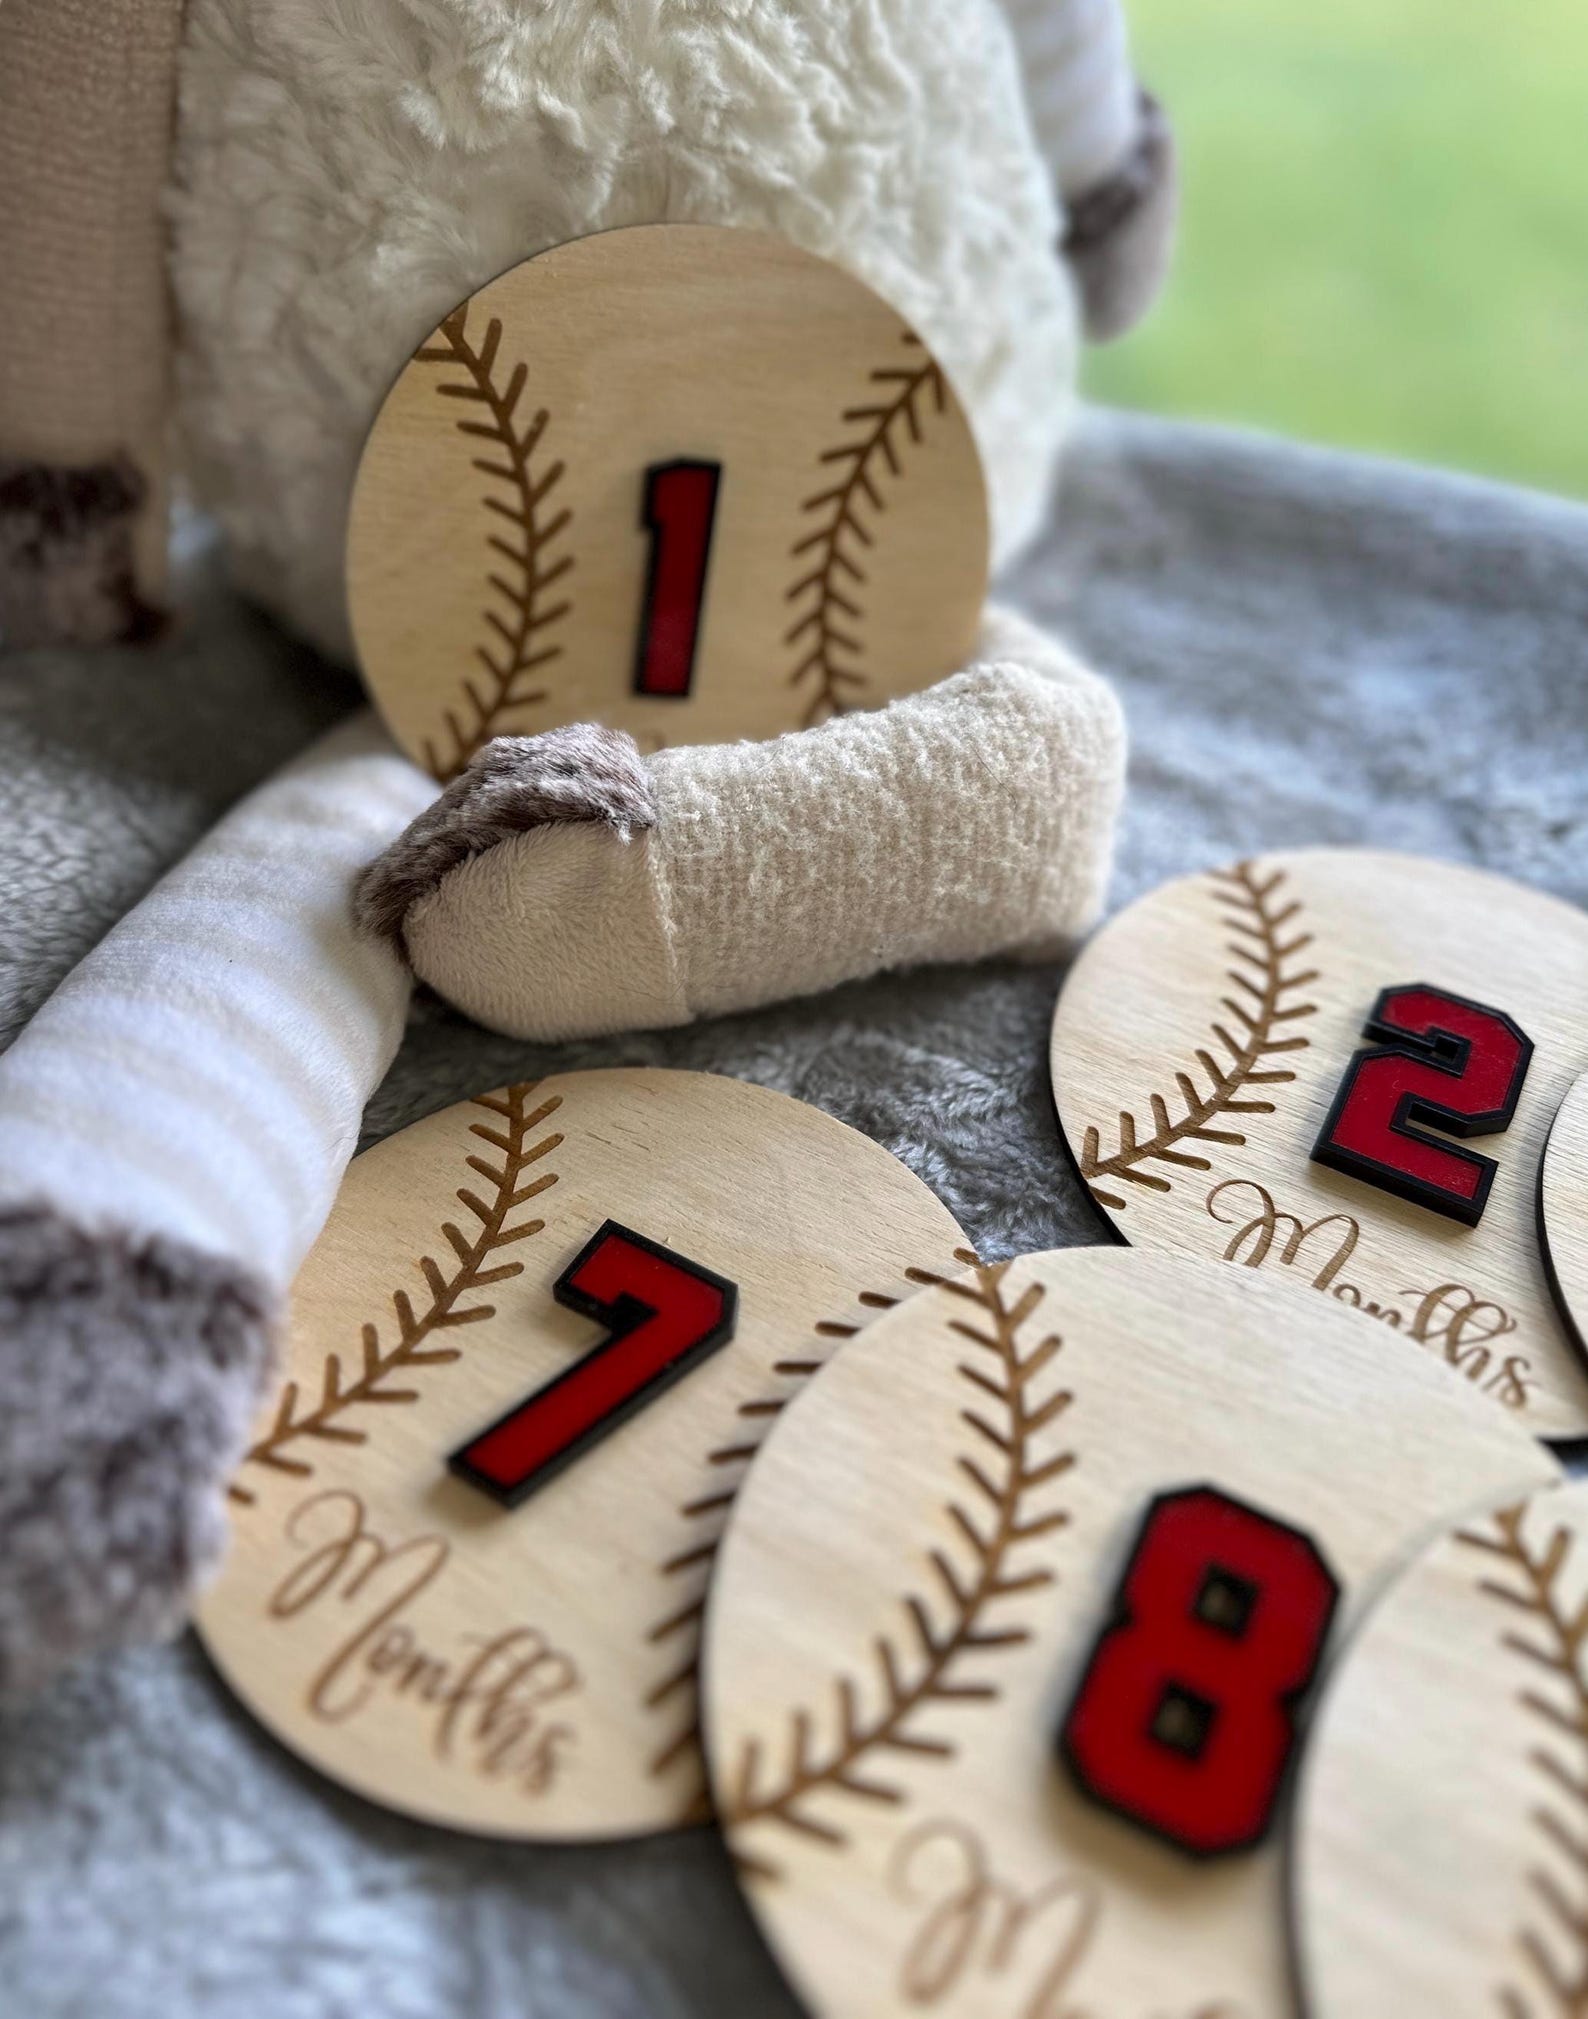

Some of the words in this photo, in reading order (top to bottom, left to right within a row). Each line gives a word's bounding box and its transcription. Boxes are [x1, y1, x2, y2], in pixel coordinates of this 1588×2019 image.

[632, 456, 723, 699] 1
[1310, 981, 1536, 1229] 2
[446, 1217, 740, 1511] 7
[266, 1487, 582, 1798] Months
[1056, 1479, 1343, 1864] 8
